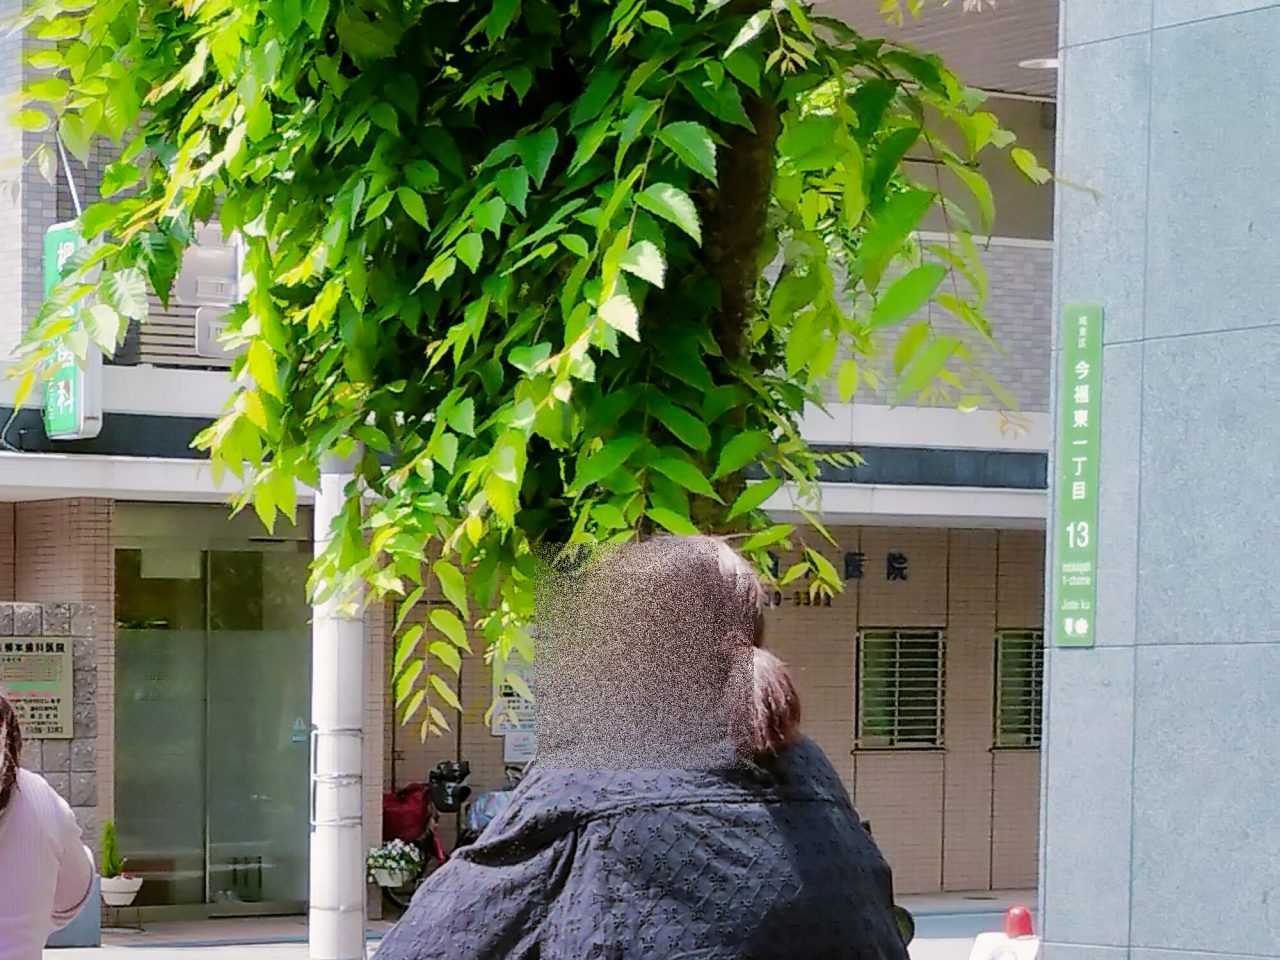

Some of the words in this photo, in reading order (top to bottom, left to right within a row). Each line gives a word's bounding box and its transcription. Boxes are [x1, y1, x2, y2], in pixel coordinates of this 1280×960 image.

[1072, 360, 1091, 500] 今福東一丁目
[1065, 520, 1090, 549] 13
